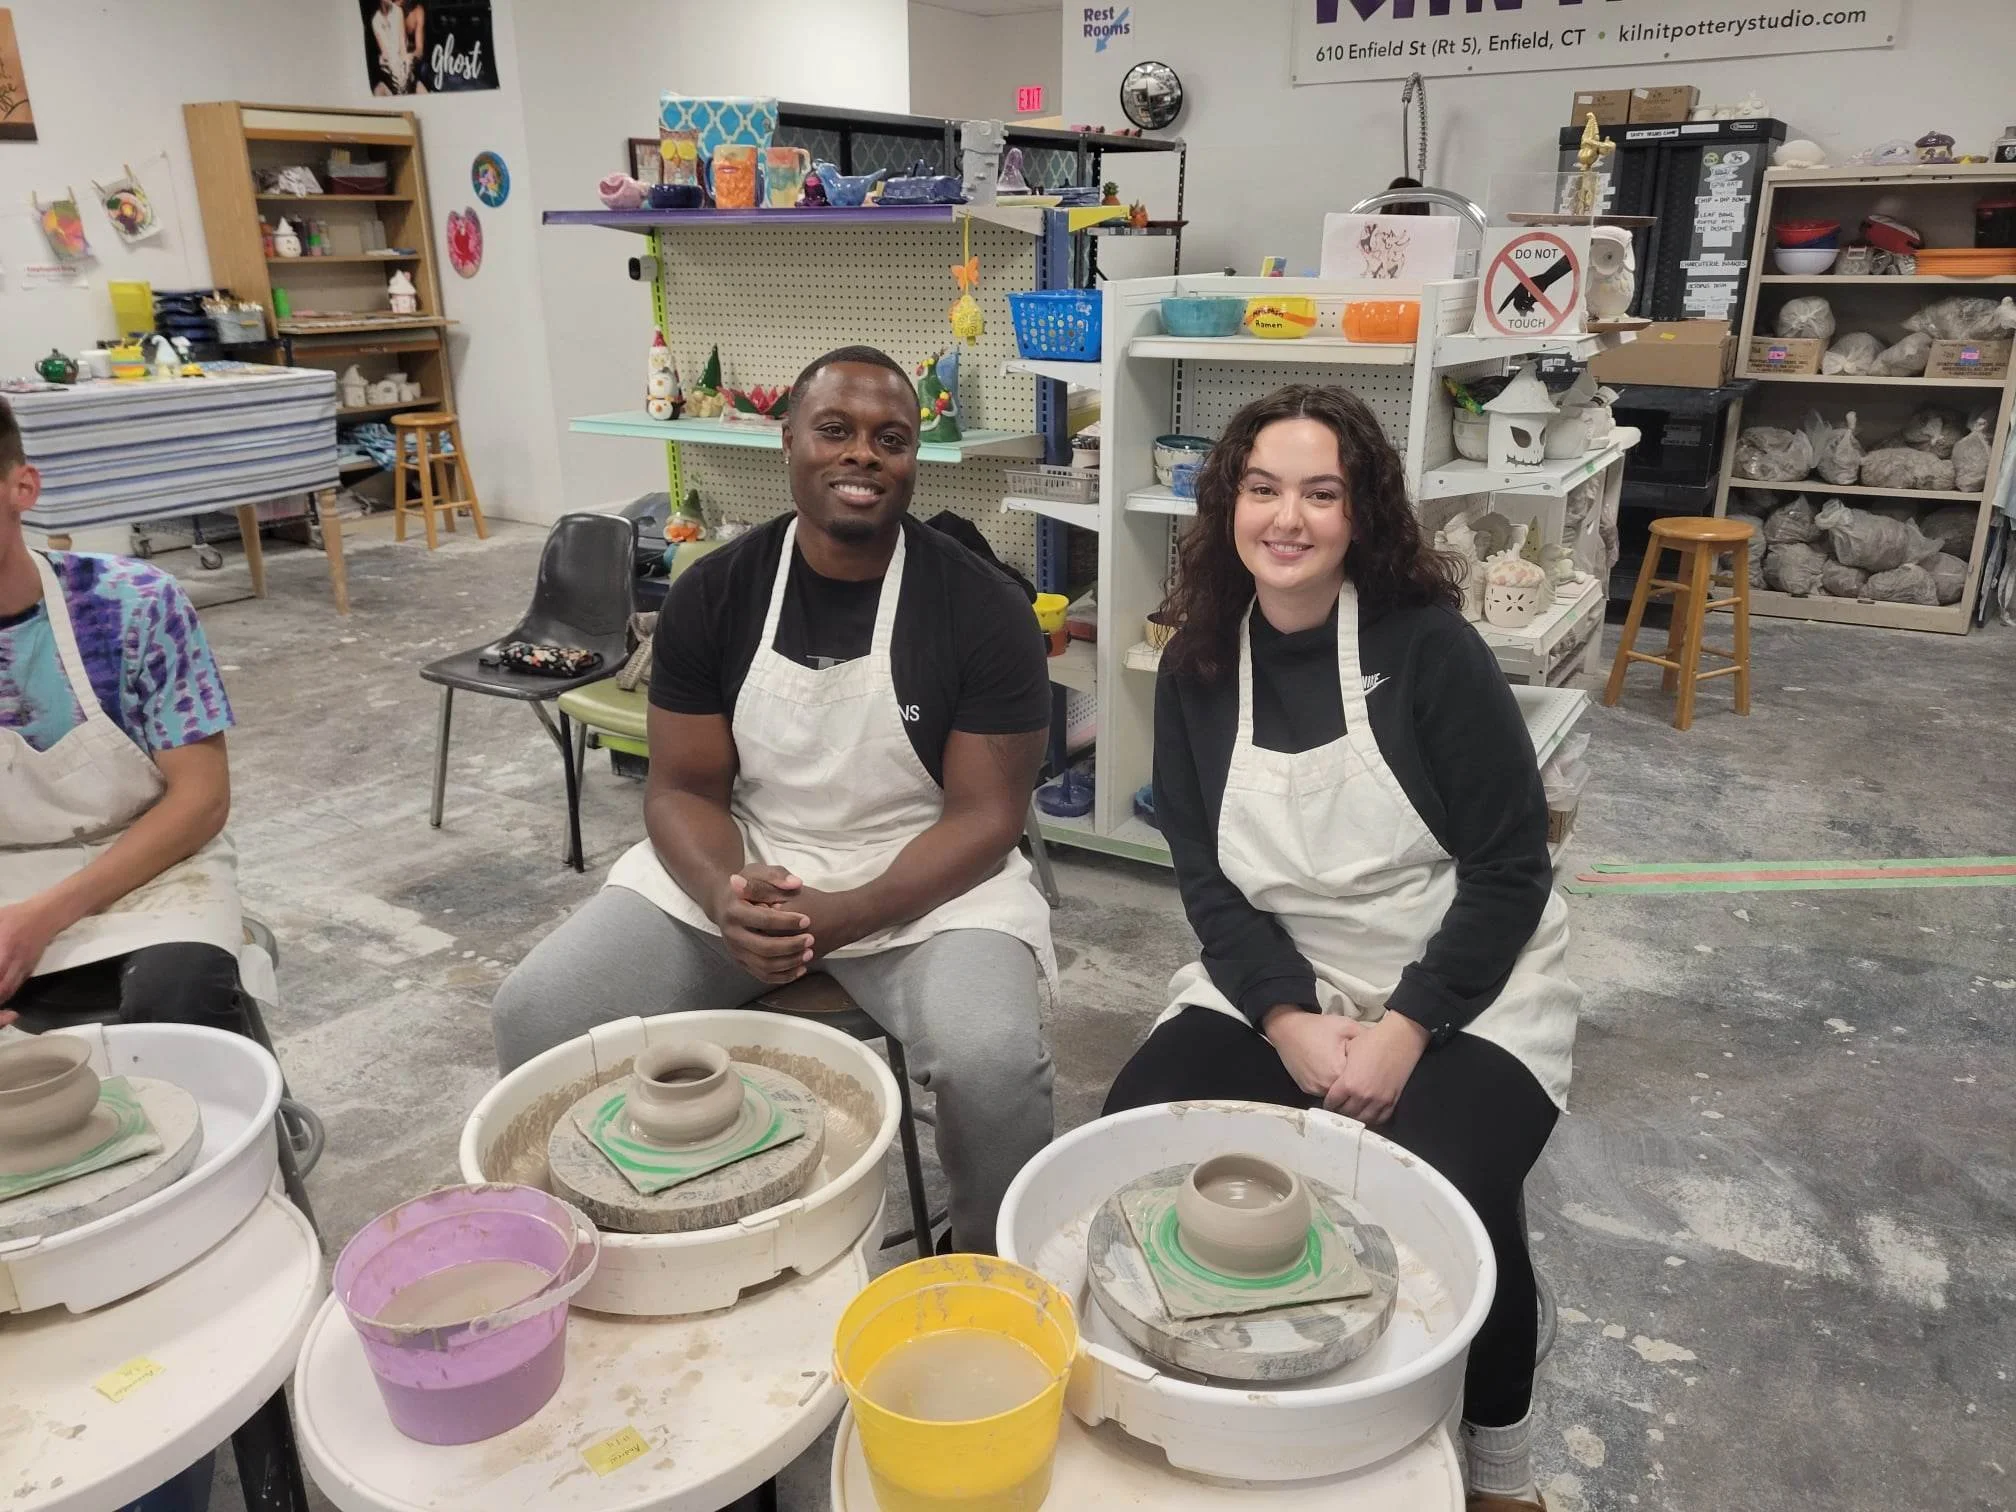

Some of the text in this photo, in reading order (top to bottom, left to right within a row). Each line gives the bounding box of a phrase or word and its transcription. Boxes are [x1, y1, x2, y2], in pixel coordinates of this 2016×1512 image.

[1083, 6, 1115, 22] Rest
[1083, 23, 1131, 37] Rooms
[1316, 45, 1344, 62] 610
[1349, 40, 1403, 59] Enfield
[1409, 39, 1427, 56] St
[1431, 38, 1455, 58] (Rt
[1461, 36, 1482, 56] 5),
[1489, 31, 1553, 51] Enfield,
[1560, 28, 1587, 46] CT
[1618, 8, 1867, 43] kilnitpotterystudio.com
[431, 32, 483, 90] ghost
[1018, 87, 1042, 111] EXIT
[1515, 248, 1559, 259] DO NOT
[1255, 319, 1283, 329] Ramen
[1507, 318, 1546, 329] TOUCH
